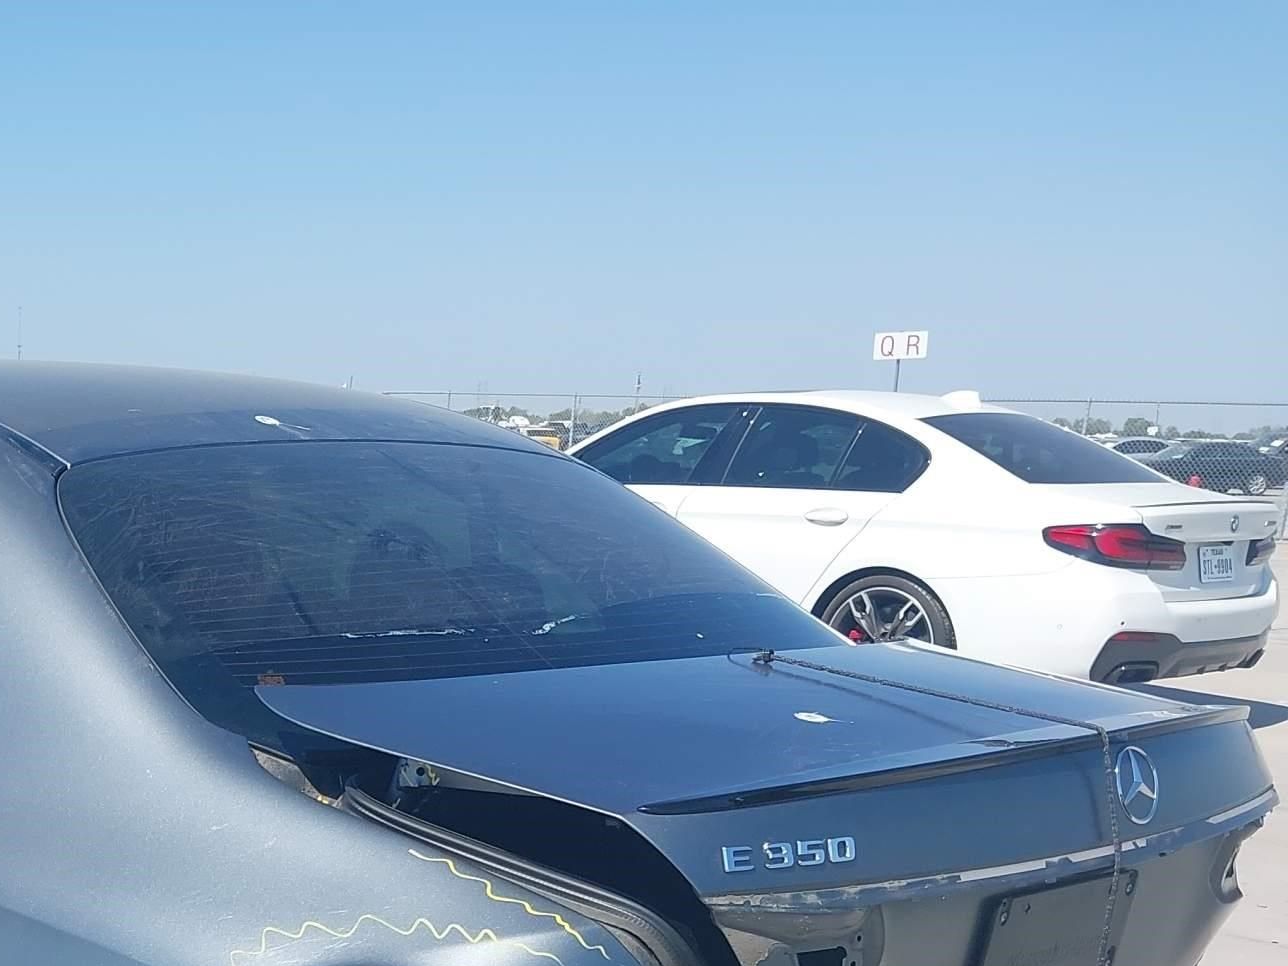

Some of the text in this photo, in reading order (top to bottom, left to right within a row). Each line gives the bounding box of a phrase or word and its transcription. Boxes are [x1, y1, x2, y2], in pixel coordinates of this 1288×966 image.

[880, 334, 921, 357] Q R
[721, 836, 856, 873] E 350
